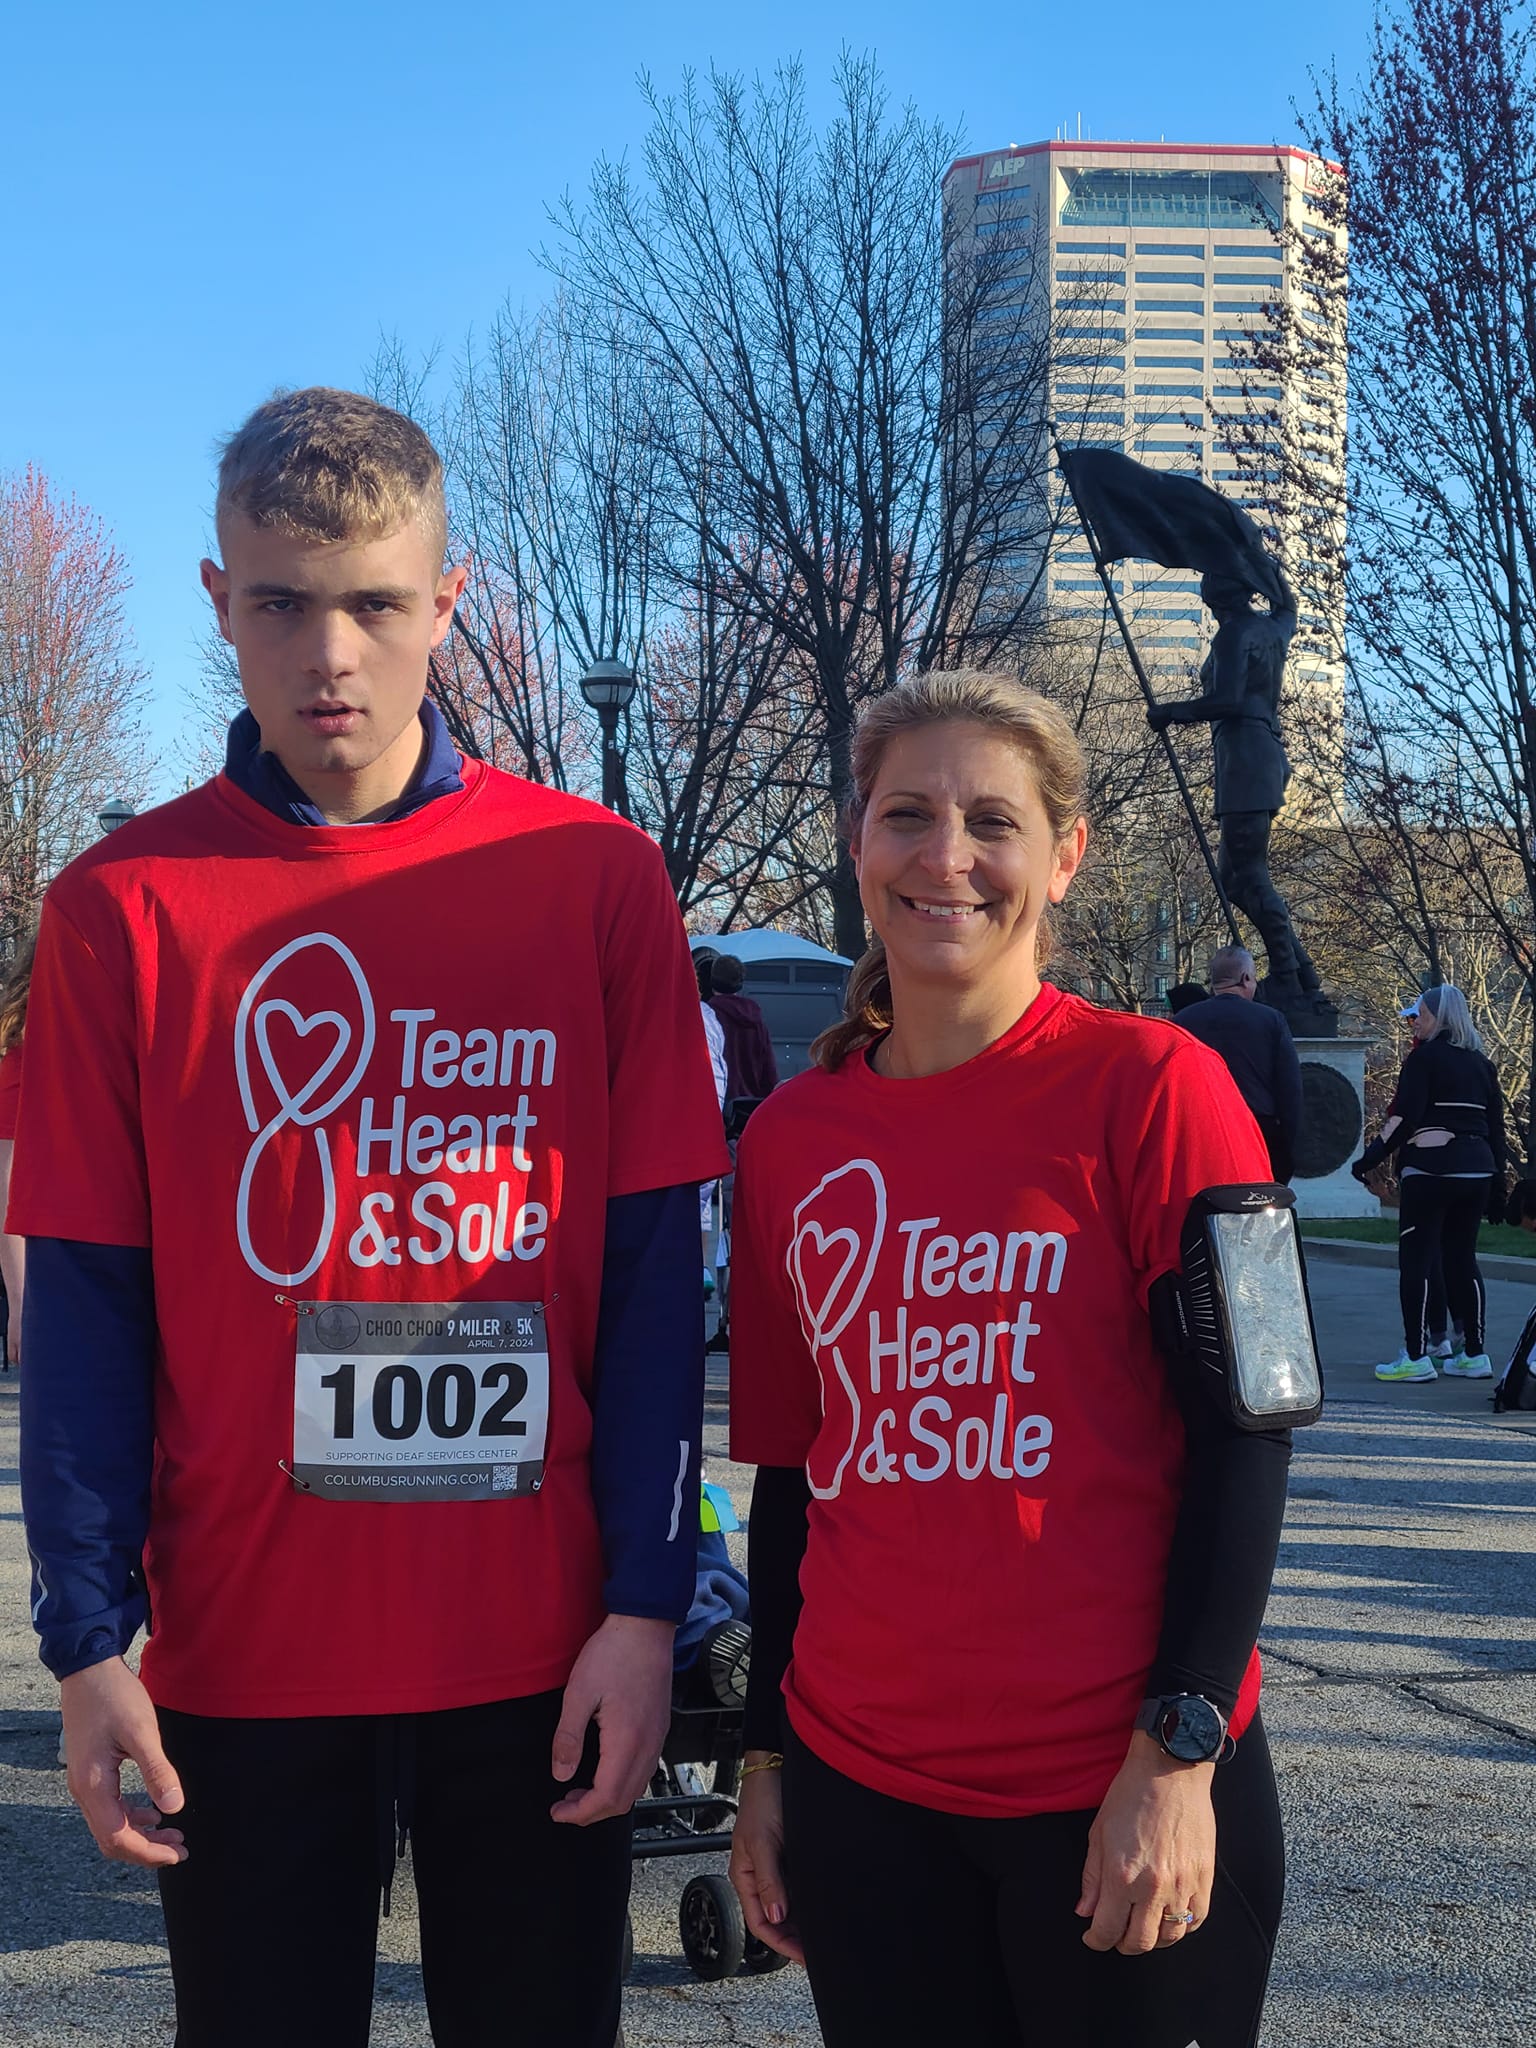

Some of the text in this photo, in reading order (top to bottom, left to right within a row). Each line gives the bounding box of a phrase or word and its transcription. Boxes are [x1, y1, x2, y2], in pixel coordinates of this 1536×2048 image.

[990, 157, 1026, 178] AEP
[390, 1008, 557, 1088] Team
[356, 1095, 538, 1177] Heart
[898, 1217, 1067, 1300] Team
[366, 1318, 533, 1337] CHOO CHOO 9 MILER & 5K
[467, 1338, 533, 1348] APRIL 7, 2024
[869, 1301, 1041, 1393] Heart
[320, 1362, 529, 1441] 1002
[324, 1473, 489, 1487] COLUMBUSRUNNING.COM
[326, 1449, 518, 1461] SUPPORTING DEAF SERVICES CENTER
